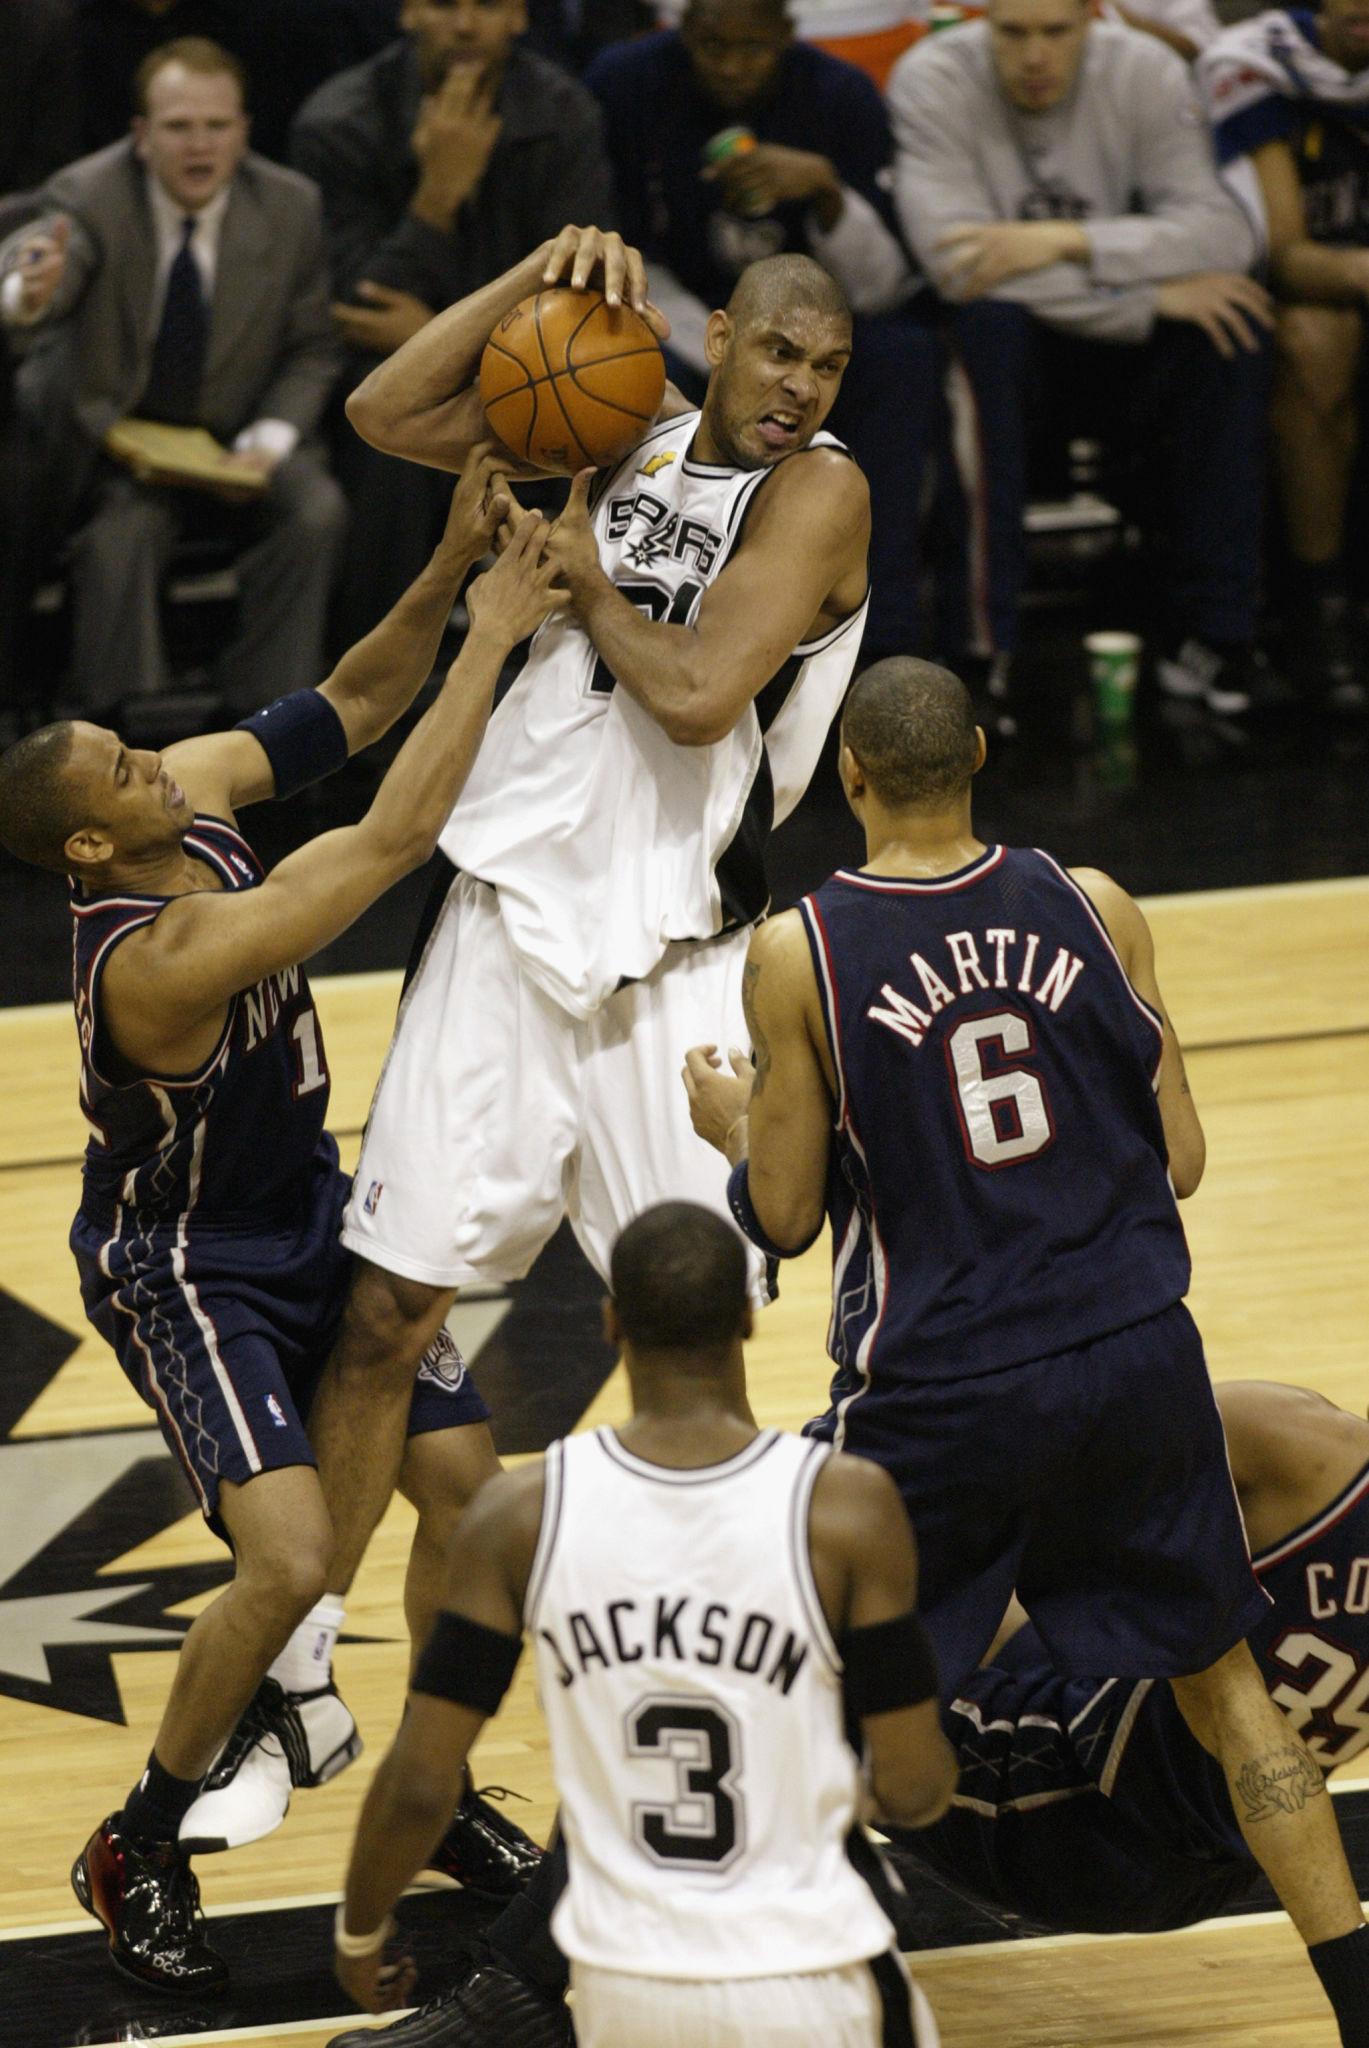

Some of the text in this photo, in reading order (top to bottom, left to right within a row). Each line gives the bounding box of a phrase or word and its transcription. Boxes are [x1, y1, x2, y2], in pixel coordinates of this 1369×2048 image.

[866, 928, 1085, 1048] MARTIN
[944, 1006, 1056, 1172] 6
[541, 1594, 809, 1696] JACKSON
[624, 1692, 747, 1873] 3
